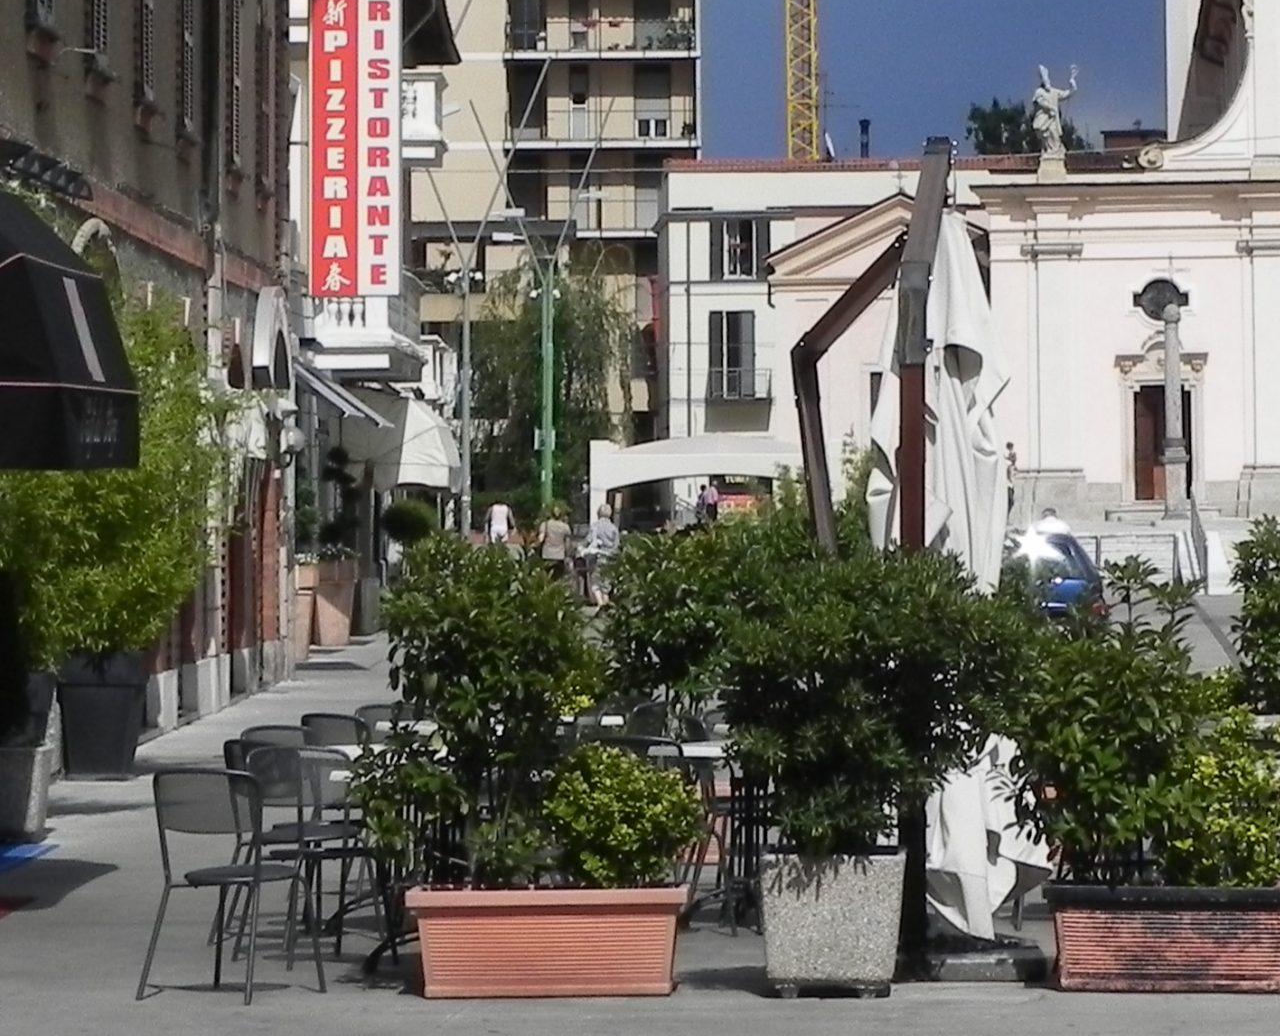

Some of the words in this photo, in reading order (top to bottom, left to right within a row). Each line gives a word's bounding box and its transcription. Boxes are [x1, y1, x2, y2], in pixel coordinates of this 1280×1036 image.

[322, 29, 349, 259] PIZZERIA
[366, 0, 391, 286] RISTORANTE
[321, 263, 351, 292] 春
